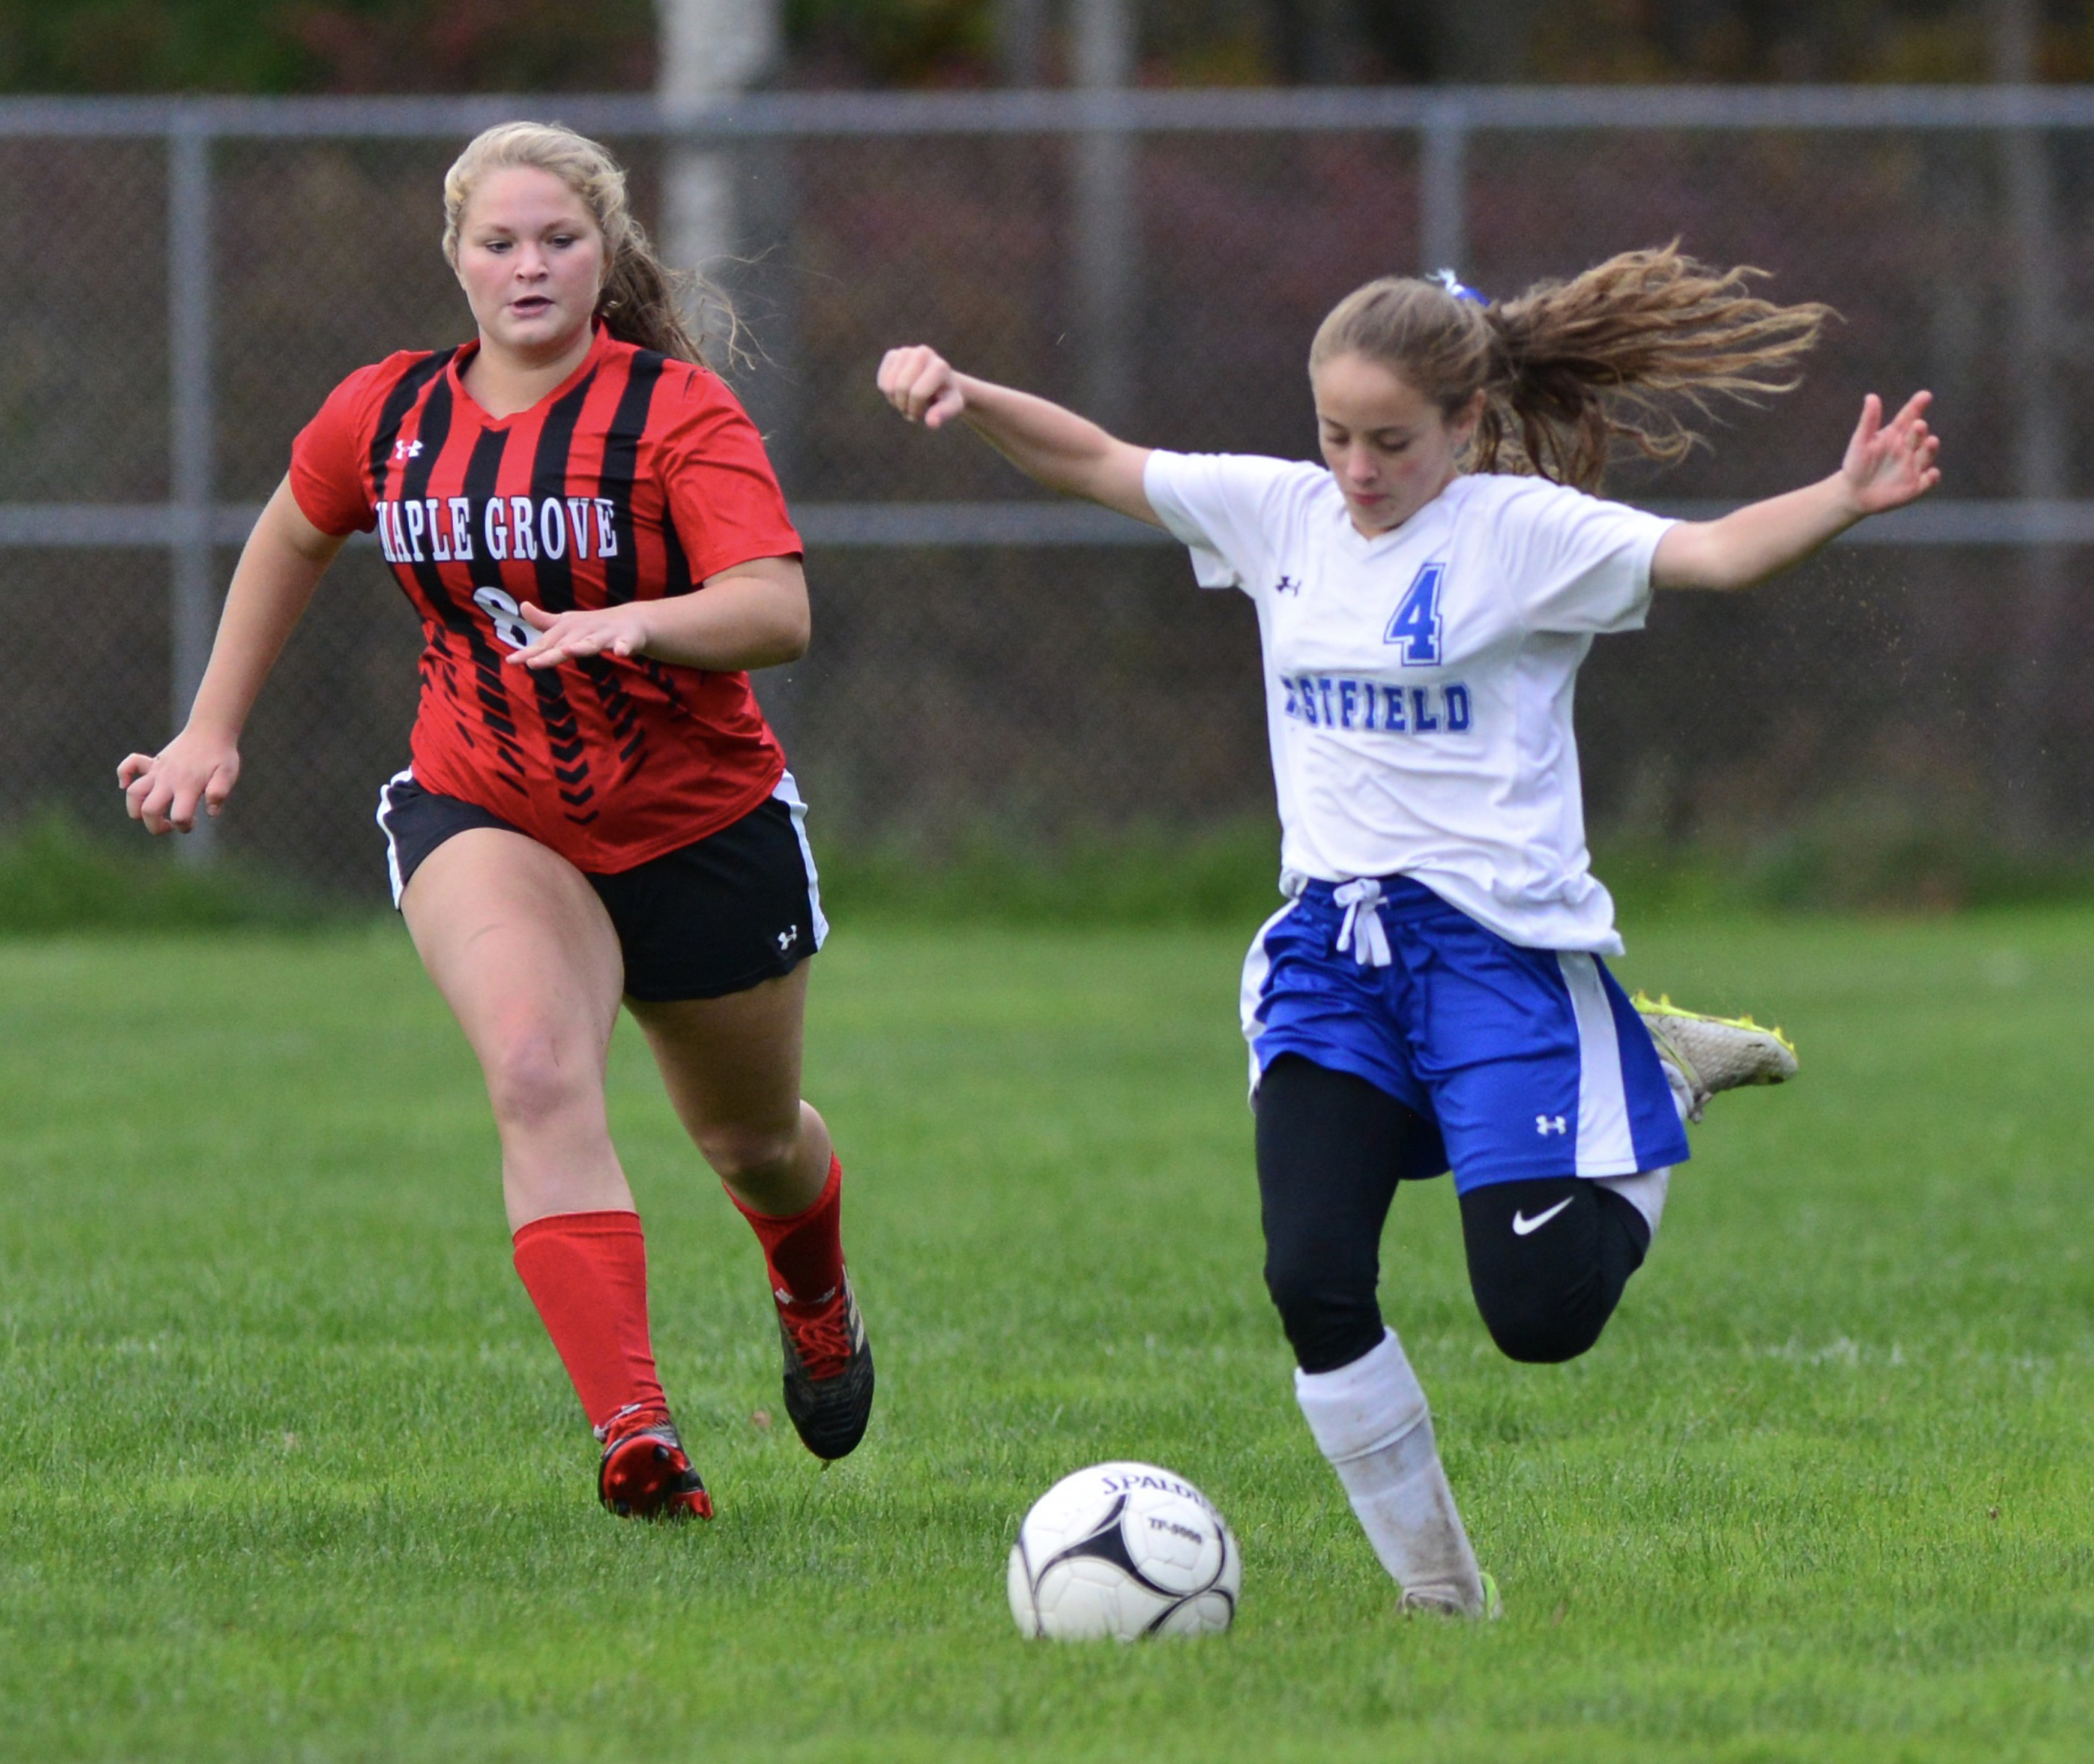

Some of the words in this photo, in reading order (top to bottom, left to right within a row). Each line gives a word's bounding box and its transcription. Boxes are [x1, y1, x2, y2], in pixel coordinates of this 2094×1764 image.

[484, 497, 618, 560] GROVE
[473, 586, 544, 651] 8
[1383, 562, 1446, 667] 4
